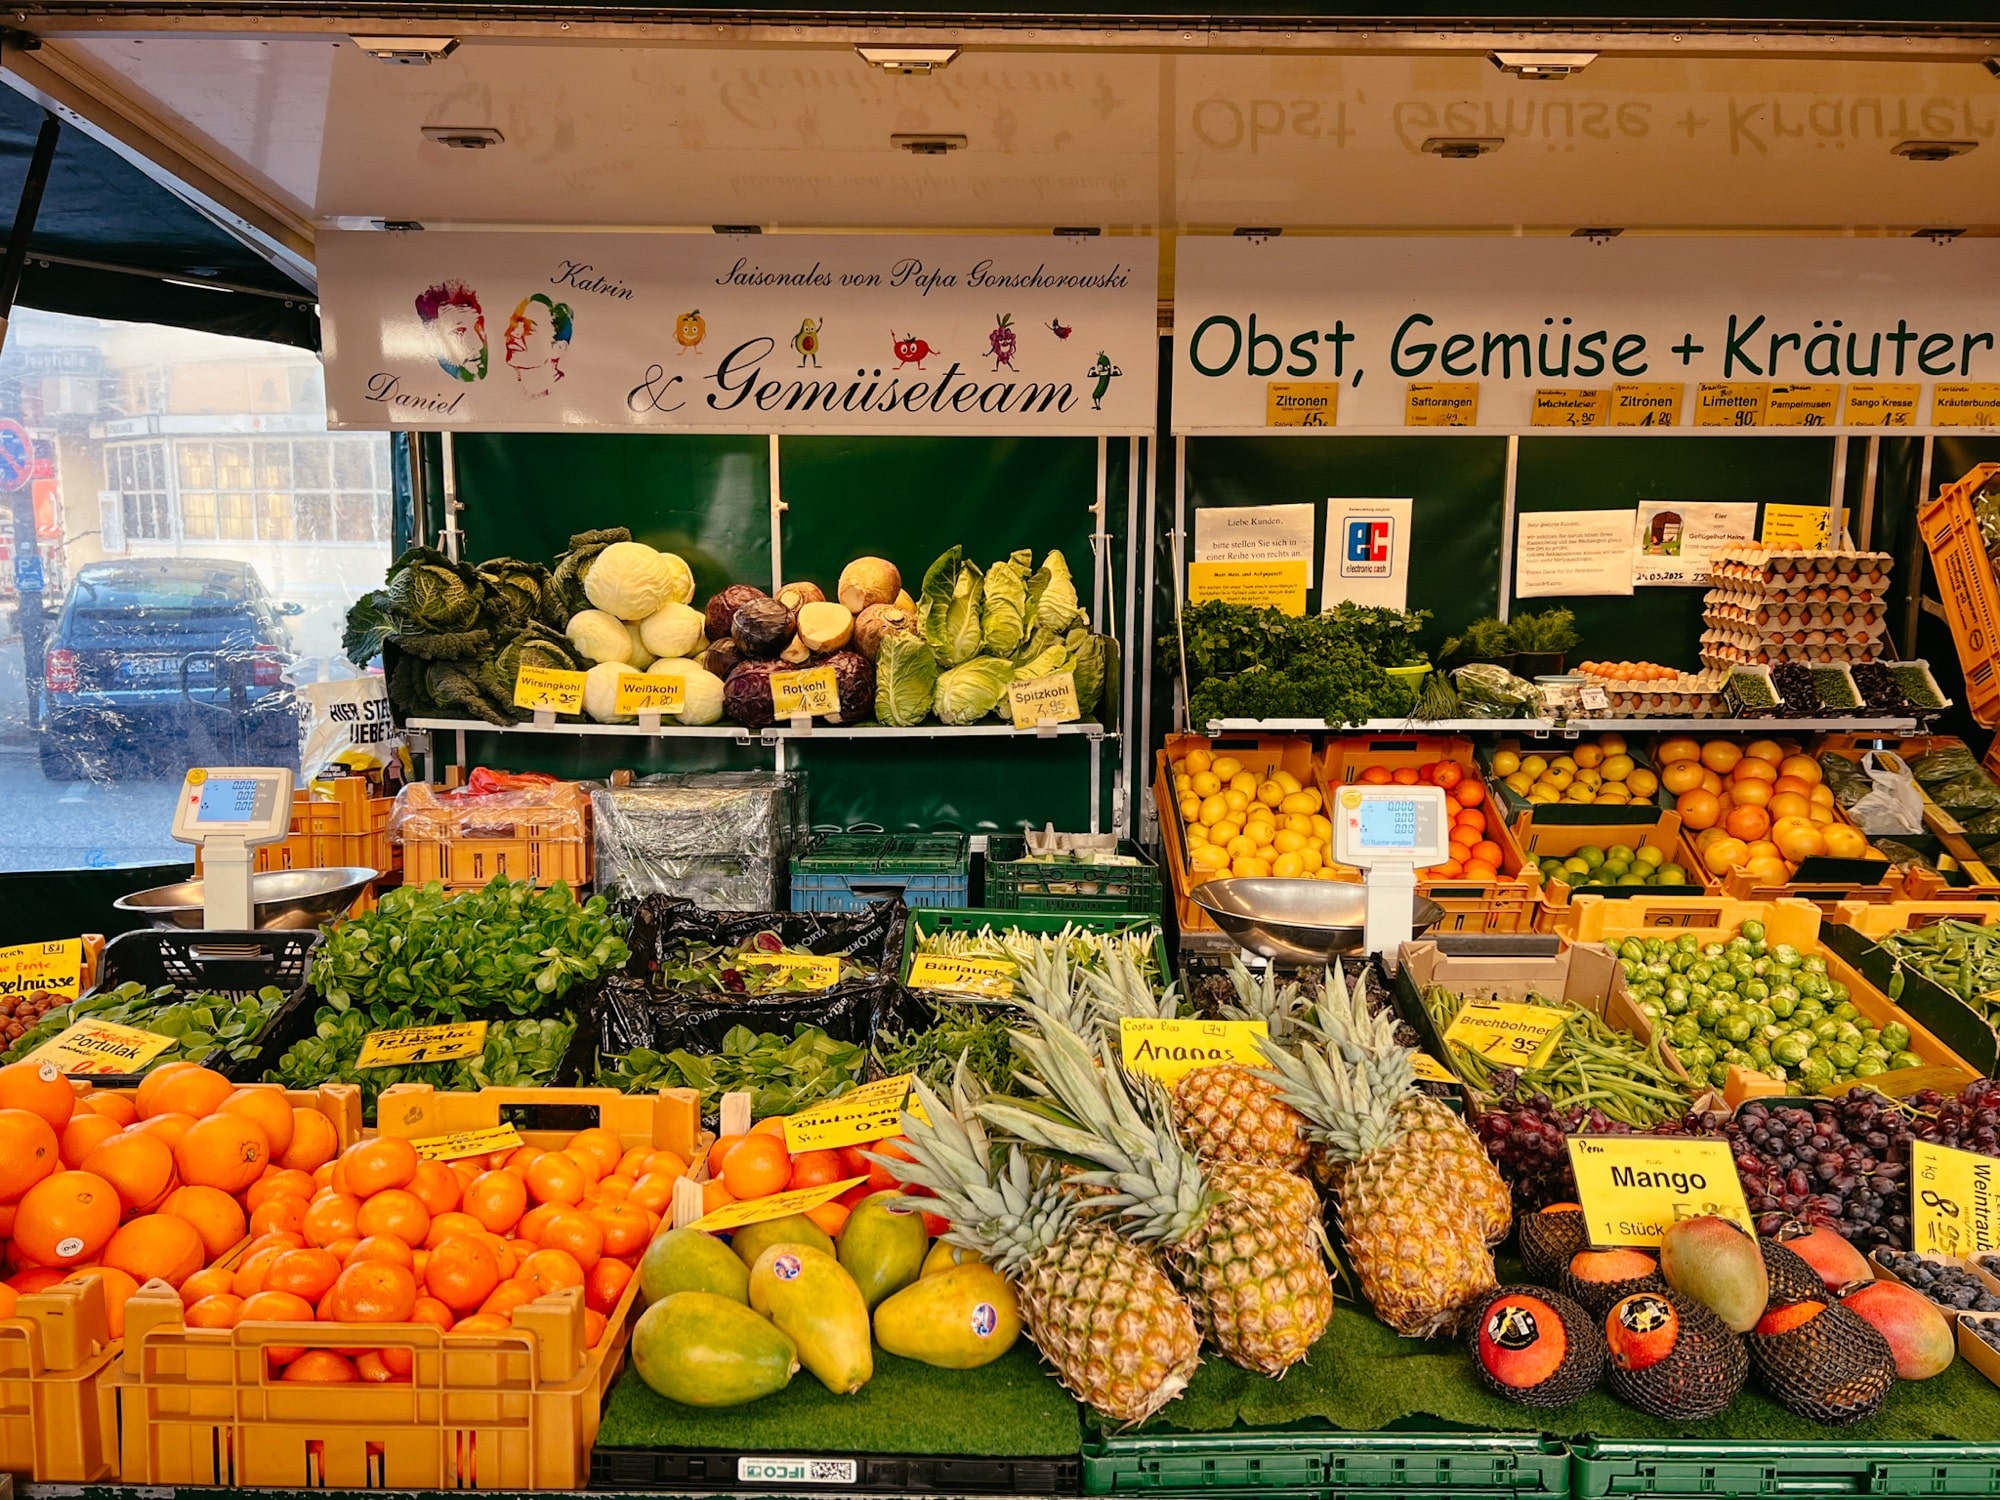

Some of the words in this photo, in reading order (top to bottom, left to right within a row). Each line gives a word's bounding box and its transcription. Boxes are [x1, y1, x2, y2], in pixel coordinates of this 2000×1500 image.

[550, 260, 634, 301] Katrin
[716, 257, 832, 287] Saisonales
[841, 272, 882, 287] von
[890, 257, 957, 297] Papa
[966, 258, 1132, 289] Gonschorowski
[1189, 313, 1364, 388] Obst,
[1390, 313, 1648, 380] Gemüse
[1671, 333, 1704, 366] +
[1724, 314, 1993, 379] Kräuter
[703, 336, 1079, 414] Gemüseteam
[365, 372, 466, 416] Daniel
[1276, 395, 1328, 407] Zitronen
[1619, 395, 1673, 407] Zitronen
[1411, 396, 1473, 409] Saftorangen
[1703, 396, 1758, 407] Limetten
[1771, 400, 1831, 410] Pampelmusen
[1851, 398, 1880, 409] Sango
[1882, 398, 1913, 407] Kresse
[1227, 518, 1249, 527] Liebe
[1212, 540, 1229, 549] bitte
[1231, 539, 1256, 549] stellen
[1258, 539, 1270, 547] Sie
[1272, 538, 1287, 547] sich
[1227, 551, 1249, 560] Reihe
[1267, 550, 1290, 559] rechts
[1346, 564, 1373, 573] electronic
[1374, 564, 1387, 573] cash
[521, 677, 580, 691] Wirsingkohl
[623, 683, 678, 694] Weißkohl
[782, 679, 826, 695] Rotkohl
[1015, 685, 1070, 704] Spitzkohl
[329, 702, 361, 722] HIER
[1123, 1021, 1154, 1032] Costa
[66, 1033, 142, 1060] Portulak
[1133, 1038, 1236, 1062] Ananas
[1579, 1140, 1605, 1155] Peru
[1610, 1165, 1708, 1195] Mango
[1921, 1165, 1938, 1181] kg
[1604, 1222, 1612, 1235] 1
[1620, 1221, 1665, 1237] Stück
[763, 1465, 805, 1478] IFCO
